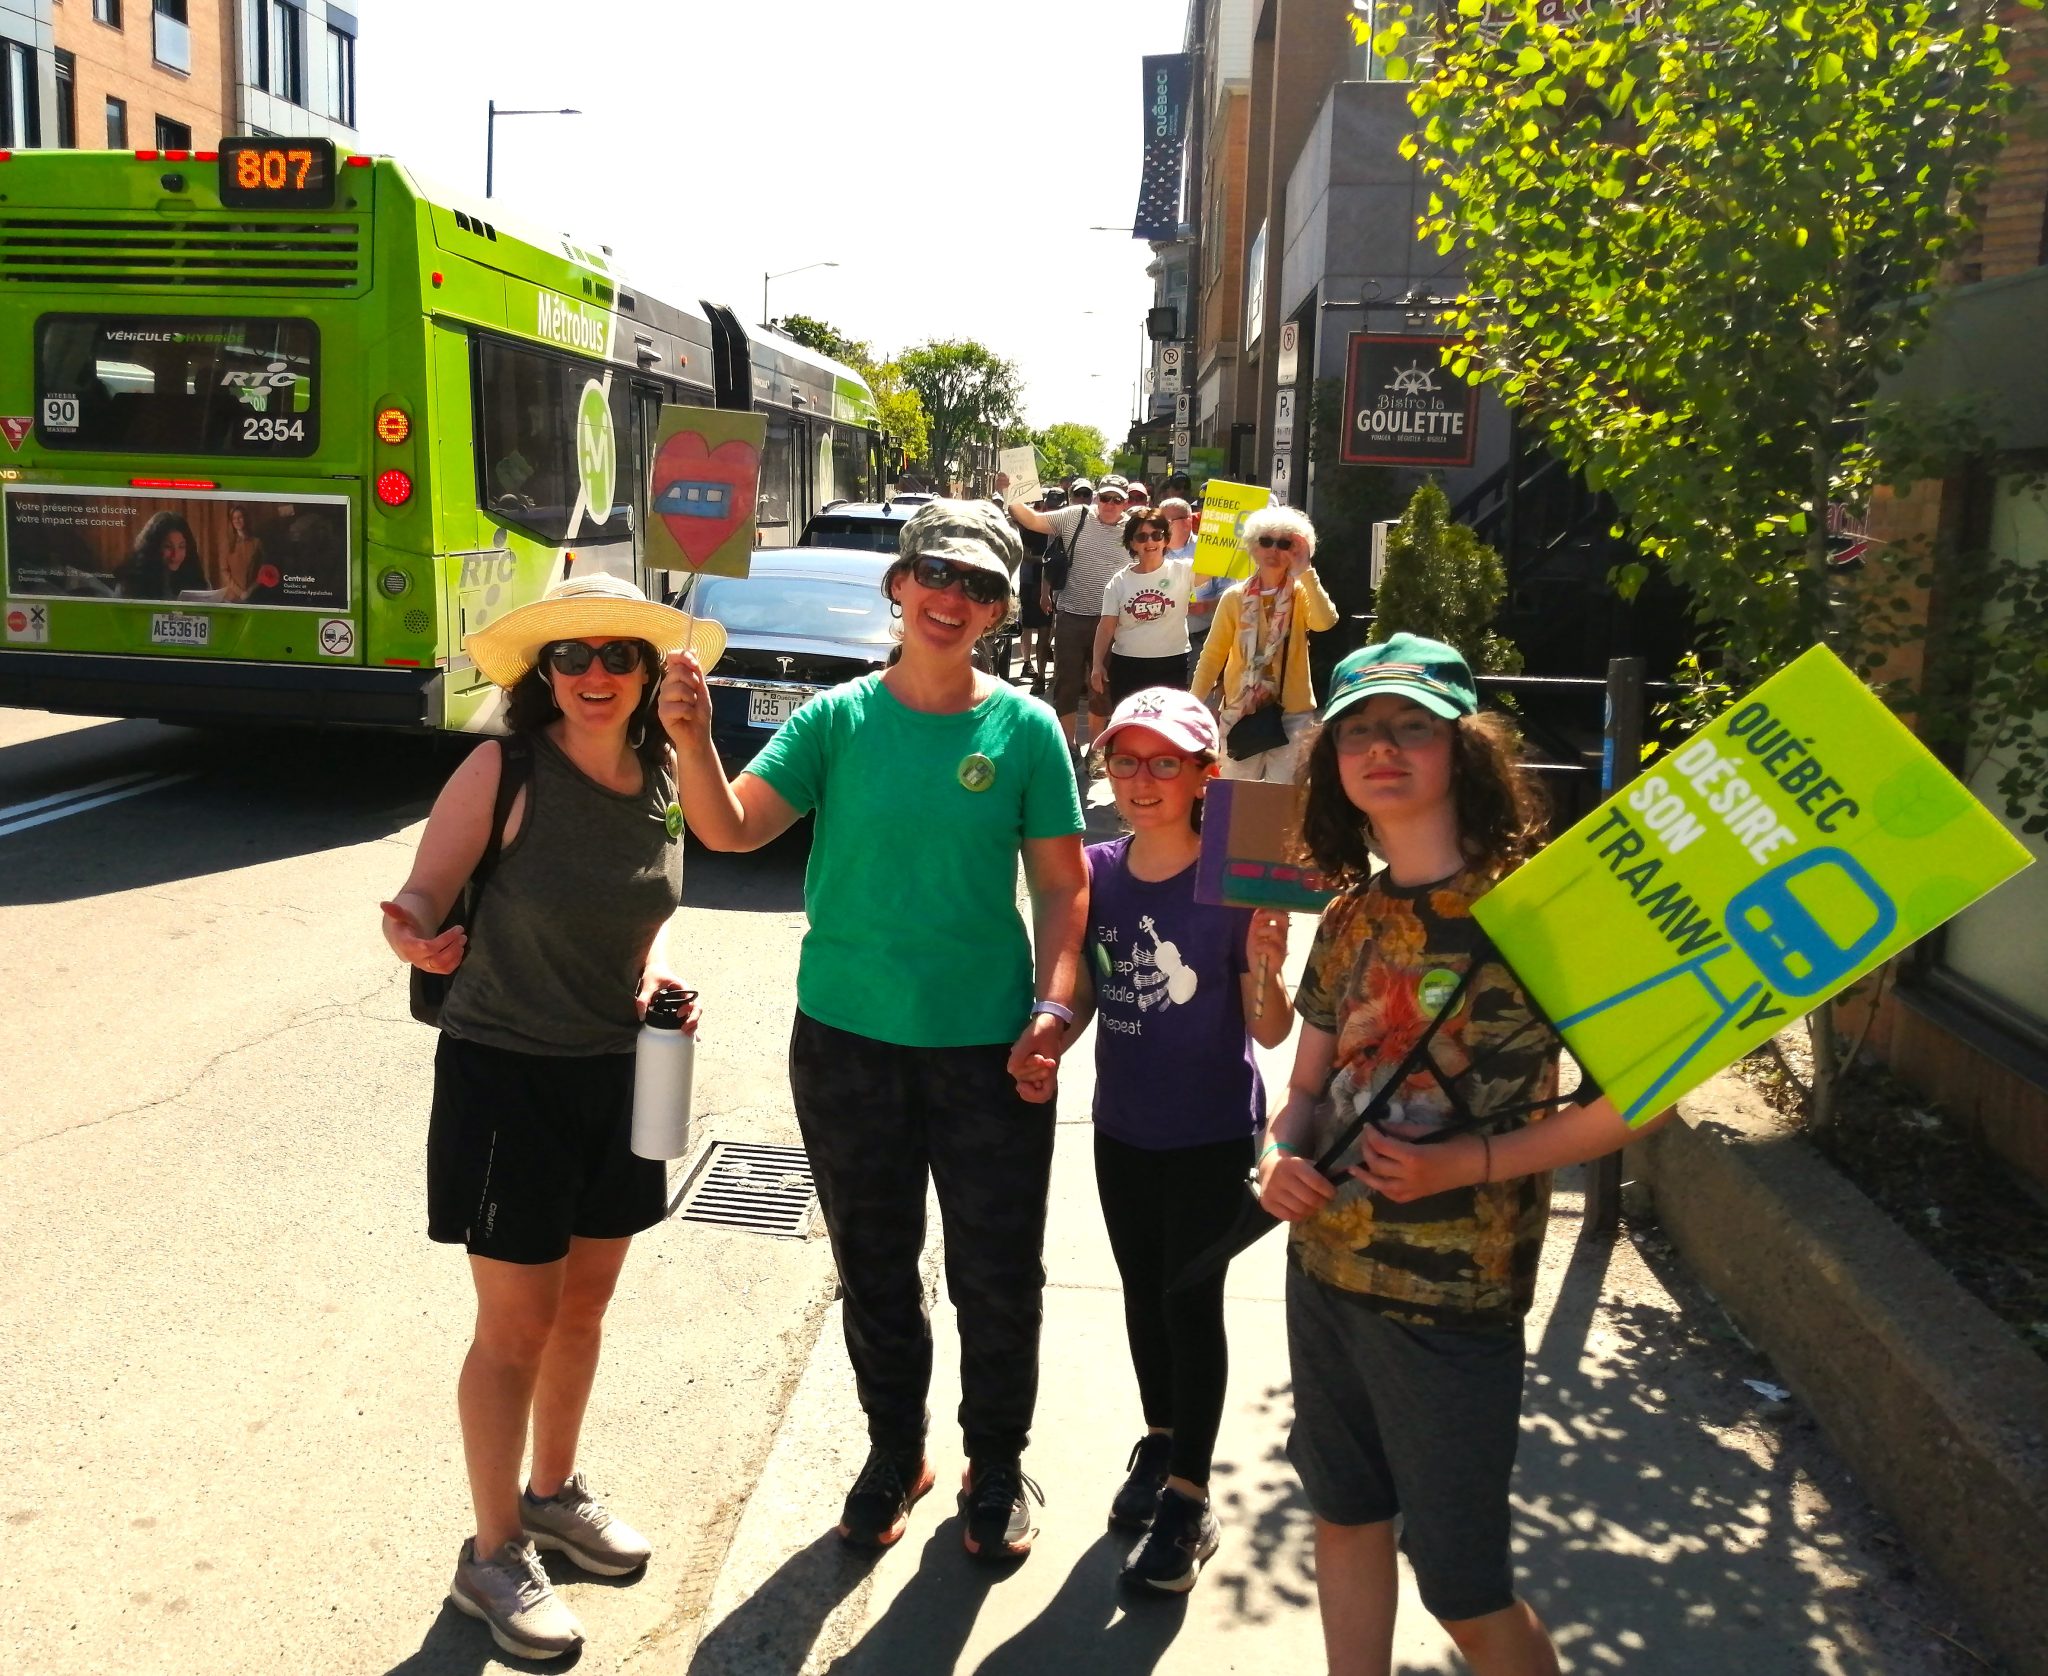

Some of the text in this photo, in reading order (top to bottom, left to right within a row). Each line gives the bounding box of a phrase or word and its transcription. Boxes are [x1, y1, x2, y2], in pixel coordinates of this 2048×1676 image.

[238, 149, 312, 190] 807
[537, 291, 604, 353] Métrobus
[221, 371, 297, 387] RTC
[48, 401, 75, 422] 90
[1377, 394, 1445, 410] Bistro la
[243, 418, 305, 442] 2354
[1357, 409, 1464, 435] GOULETTE
[15, 500, 40, 511] Votre
[42, 503, 84, 514] présence
[85, 505, 99, 514] est
[1206, 496, 1240, 511] QUÉBEC
[16, 515, 126, 527] votre impact est concret.
[1203, 509, 1236, 523] DÉSIRE
[283, 574, 316, 583] Centraide
[460, 551, 517, 590] RTC
[153, 620, 207, 639] AE53618
[753, 699, 779, 716] H35
[1726, 701, 1860, 835] QUÉBEC
[1672, 737, 1798, 867] DÉSIRE
[1627, 777, 1706, 856] SON
[1098, 926, 1119, 943] Eat
[1101, 1012, 1142, 1036] Repeat
[486, 1202, 498, 1233] CRAFT
